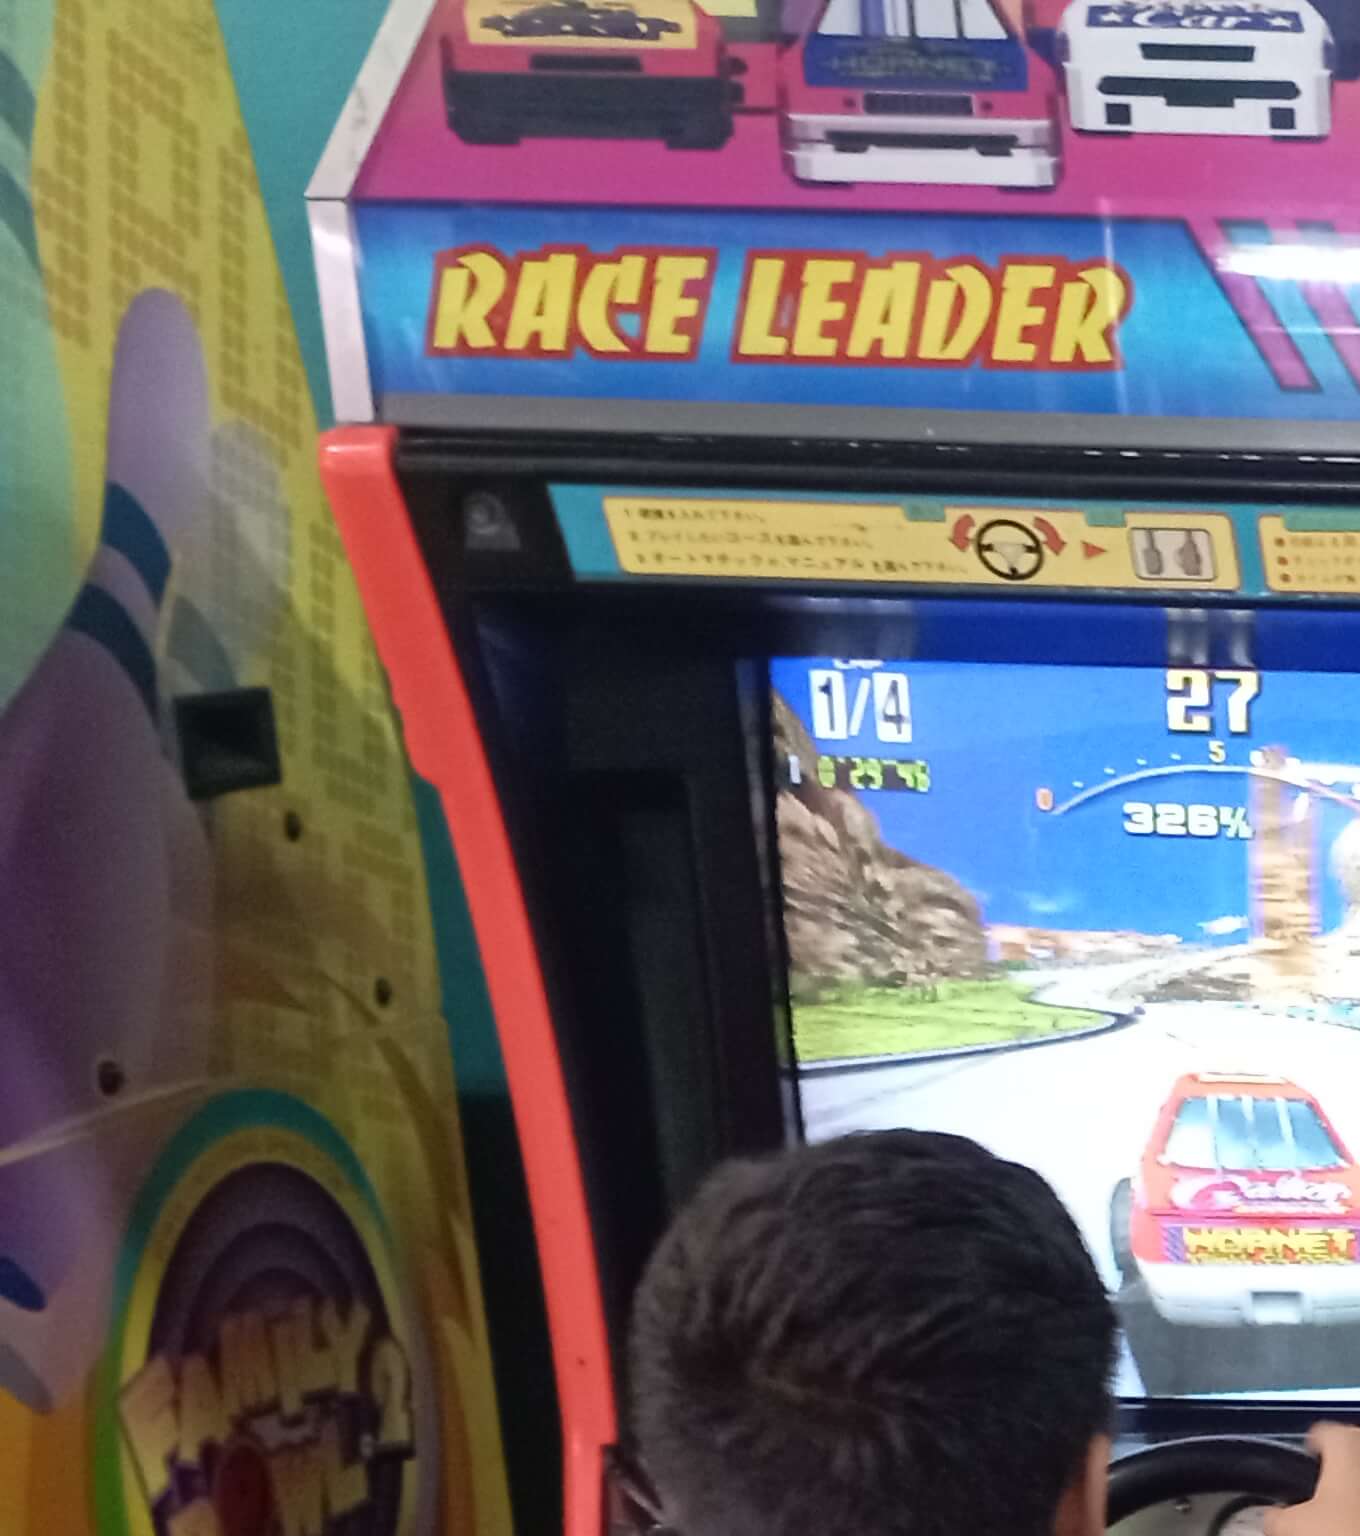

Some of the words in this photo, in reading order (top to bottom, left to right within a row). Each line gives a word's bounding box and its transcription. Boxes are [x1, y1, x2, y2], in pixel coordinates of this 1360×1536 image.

[432, 252, 710, 356] RACE
[738, 255, 1125, 363] LEADER
[809, 669, 912, 743] 1/4
[1166, 669, 1260, 733] 27
